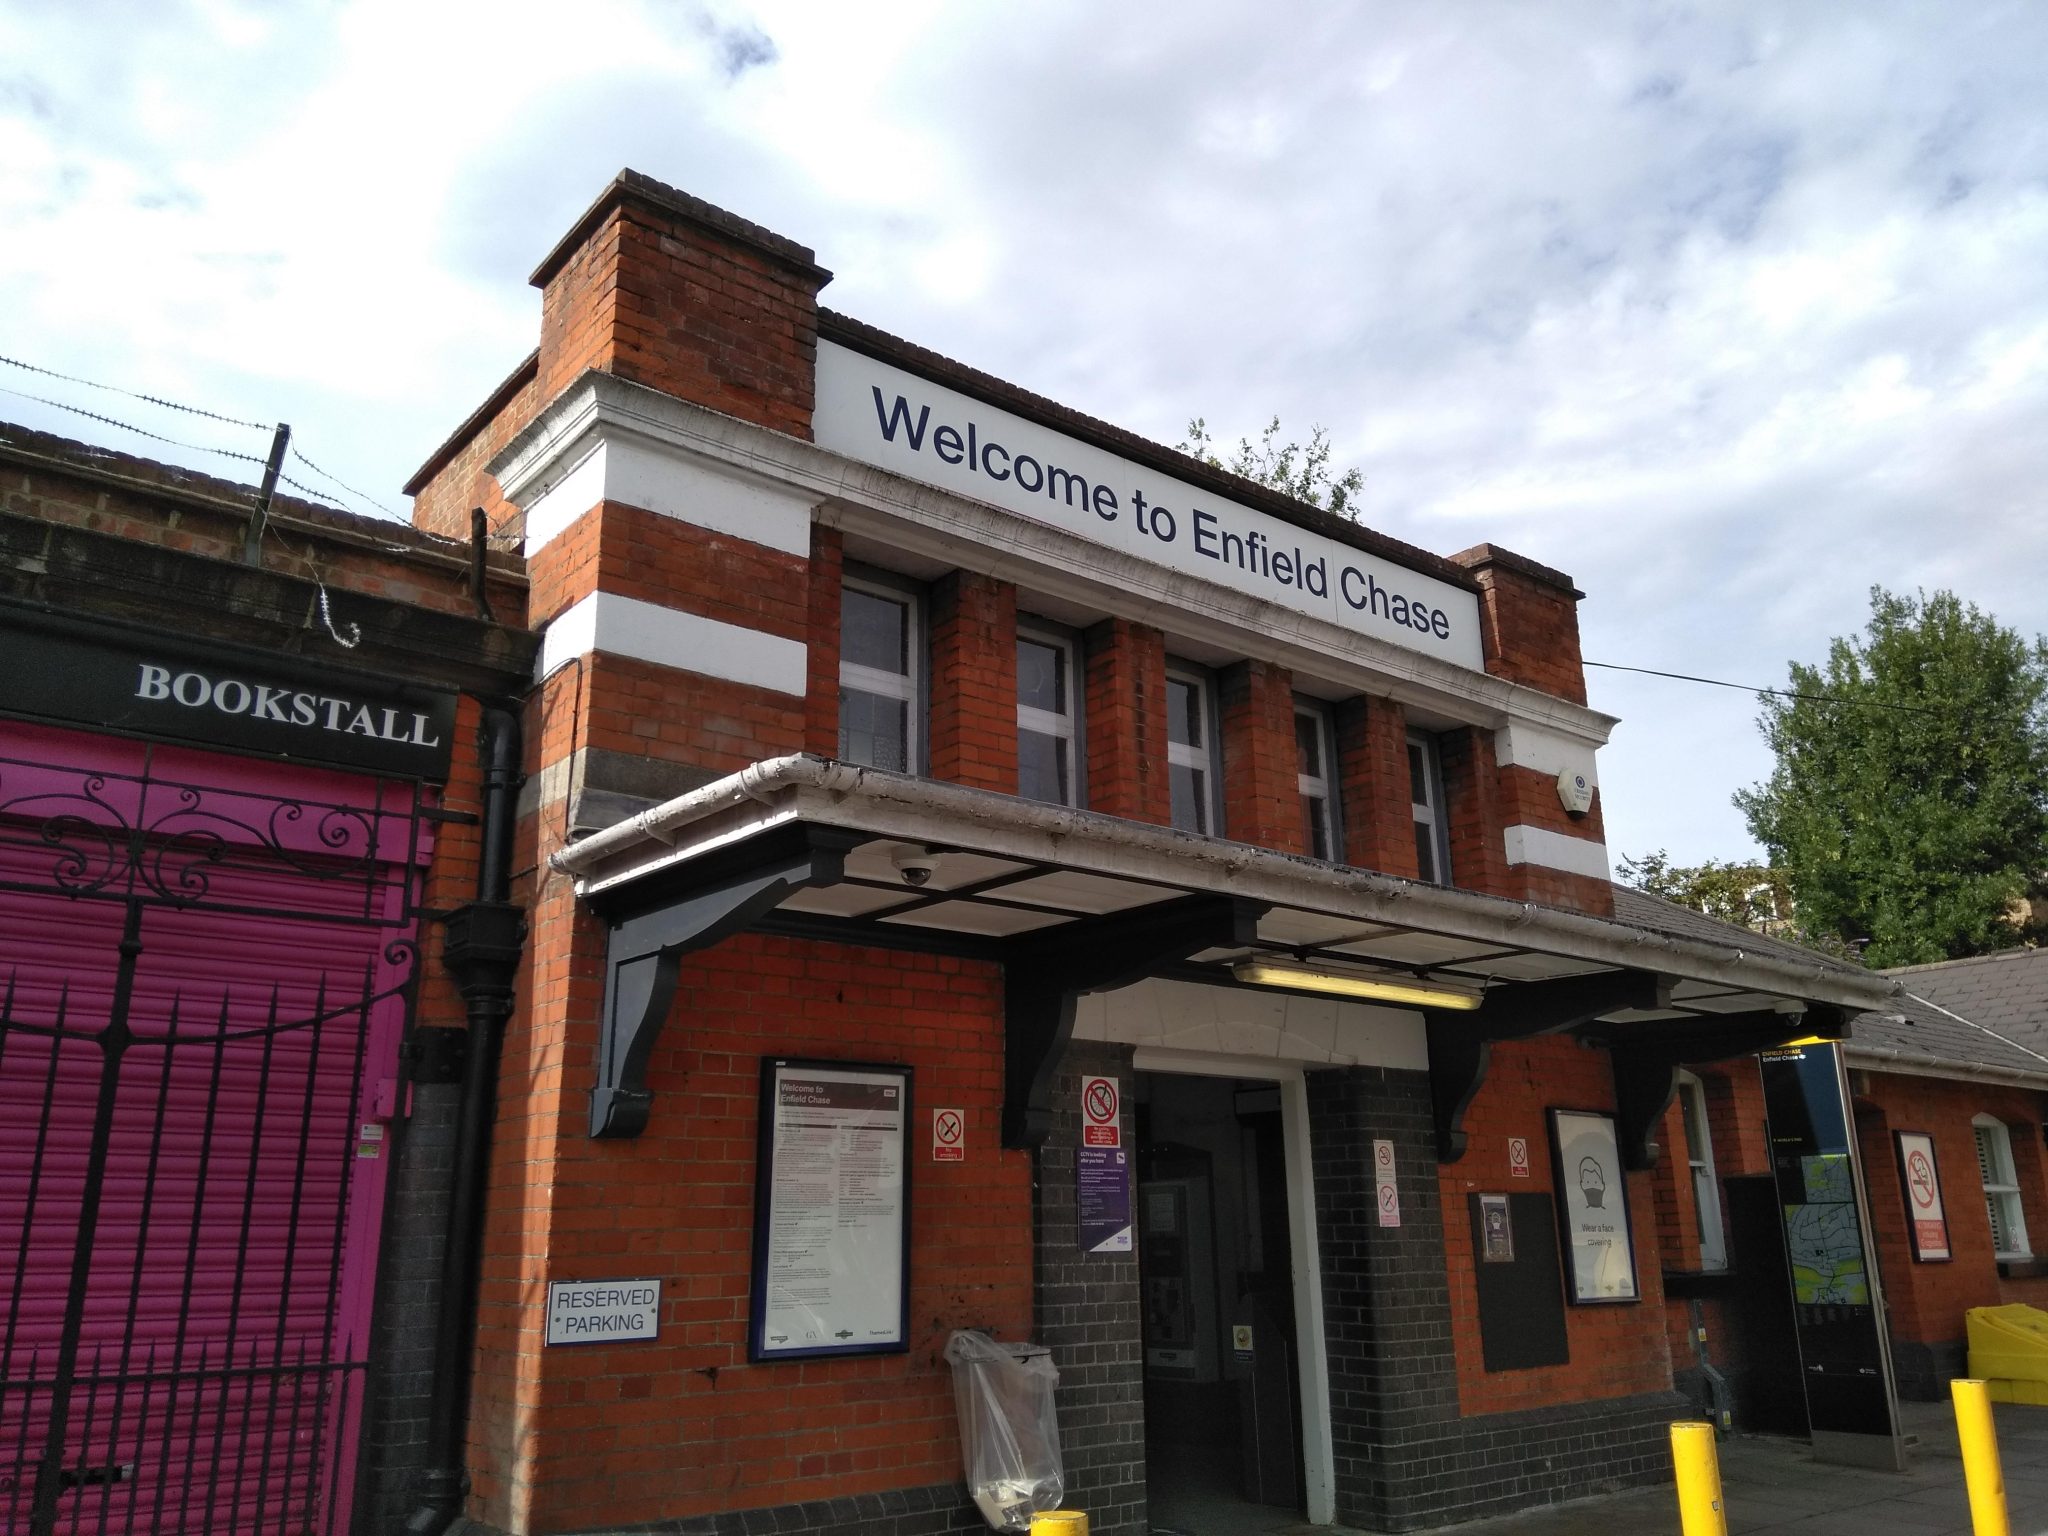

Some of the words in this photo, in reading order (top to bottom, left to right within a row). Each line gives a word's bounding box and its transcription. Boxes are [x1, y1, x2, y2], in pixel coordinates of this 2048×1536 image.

[872, 385, 1118, 522] Welcome
[1132, 489, 1177, 543] to
[1193, 508, 1328, 600] Enfield
[1340, 566, 1450, 640] Chase
[134, 664, 439, 747] BOOKSTALL
[781, 1084, 814, 1093] Welcome
[815, 1086, 823, 1094] to
[781, 1094, 806, 1103] Enfield
[808, 1095, 831, 1105] Chase
[1581, 1223, 1597, 1232] Wear
[1602, 1223, 1614, 1232] face
[1587, 1237, 1612, 1248] covering
[557, 1289, 655, 1309] RESERVED
[566, 1313, 644, 1334] PARKING
